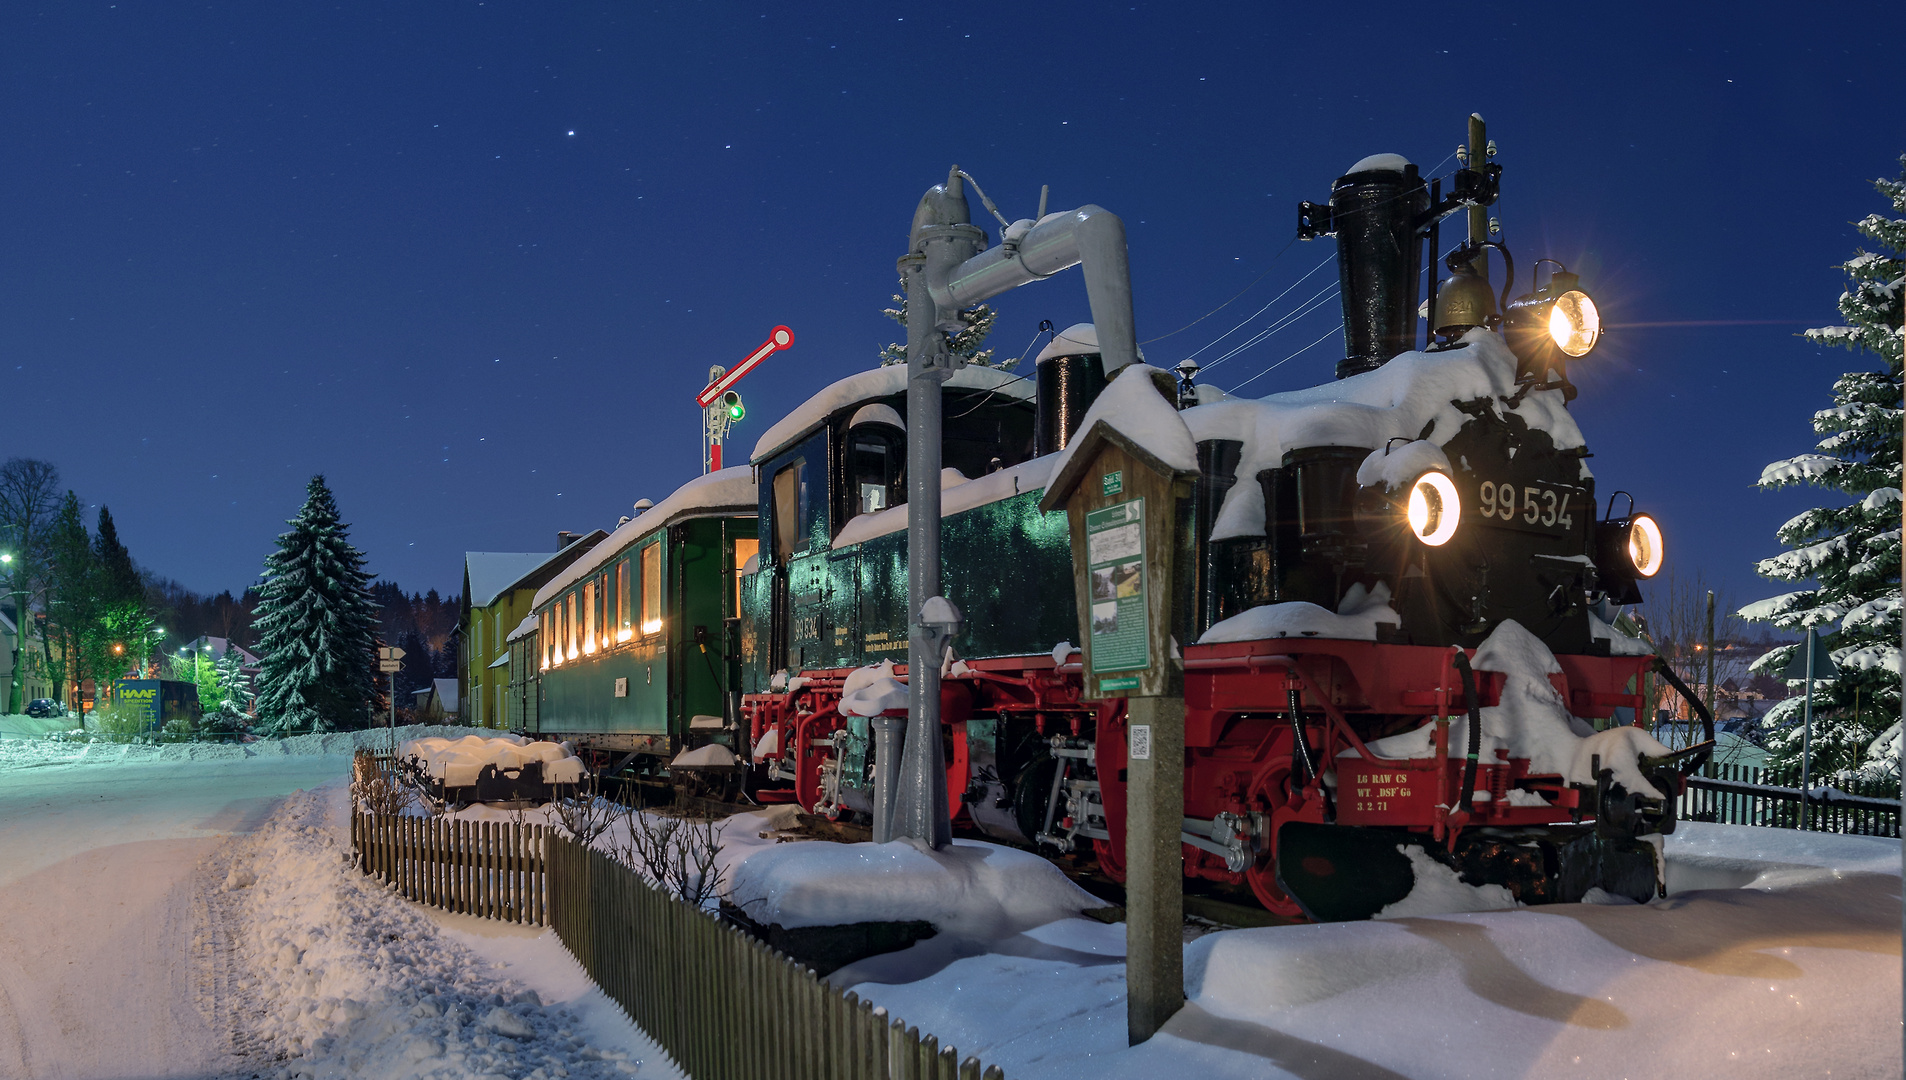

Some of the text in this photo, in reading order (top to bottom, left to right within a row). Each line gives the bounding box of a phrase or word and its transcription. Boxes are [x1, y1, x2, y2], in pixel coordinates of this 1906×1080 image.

[1480, 480, 1573, 531] 99 534
[795, 616, 818, 640] 99 534
[120, 689, 156, 698] HAAF
[1372, 774, 1392, 784] RAW
[1395, 774, 1407, 784] CS
